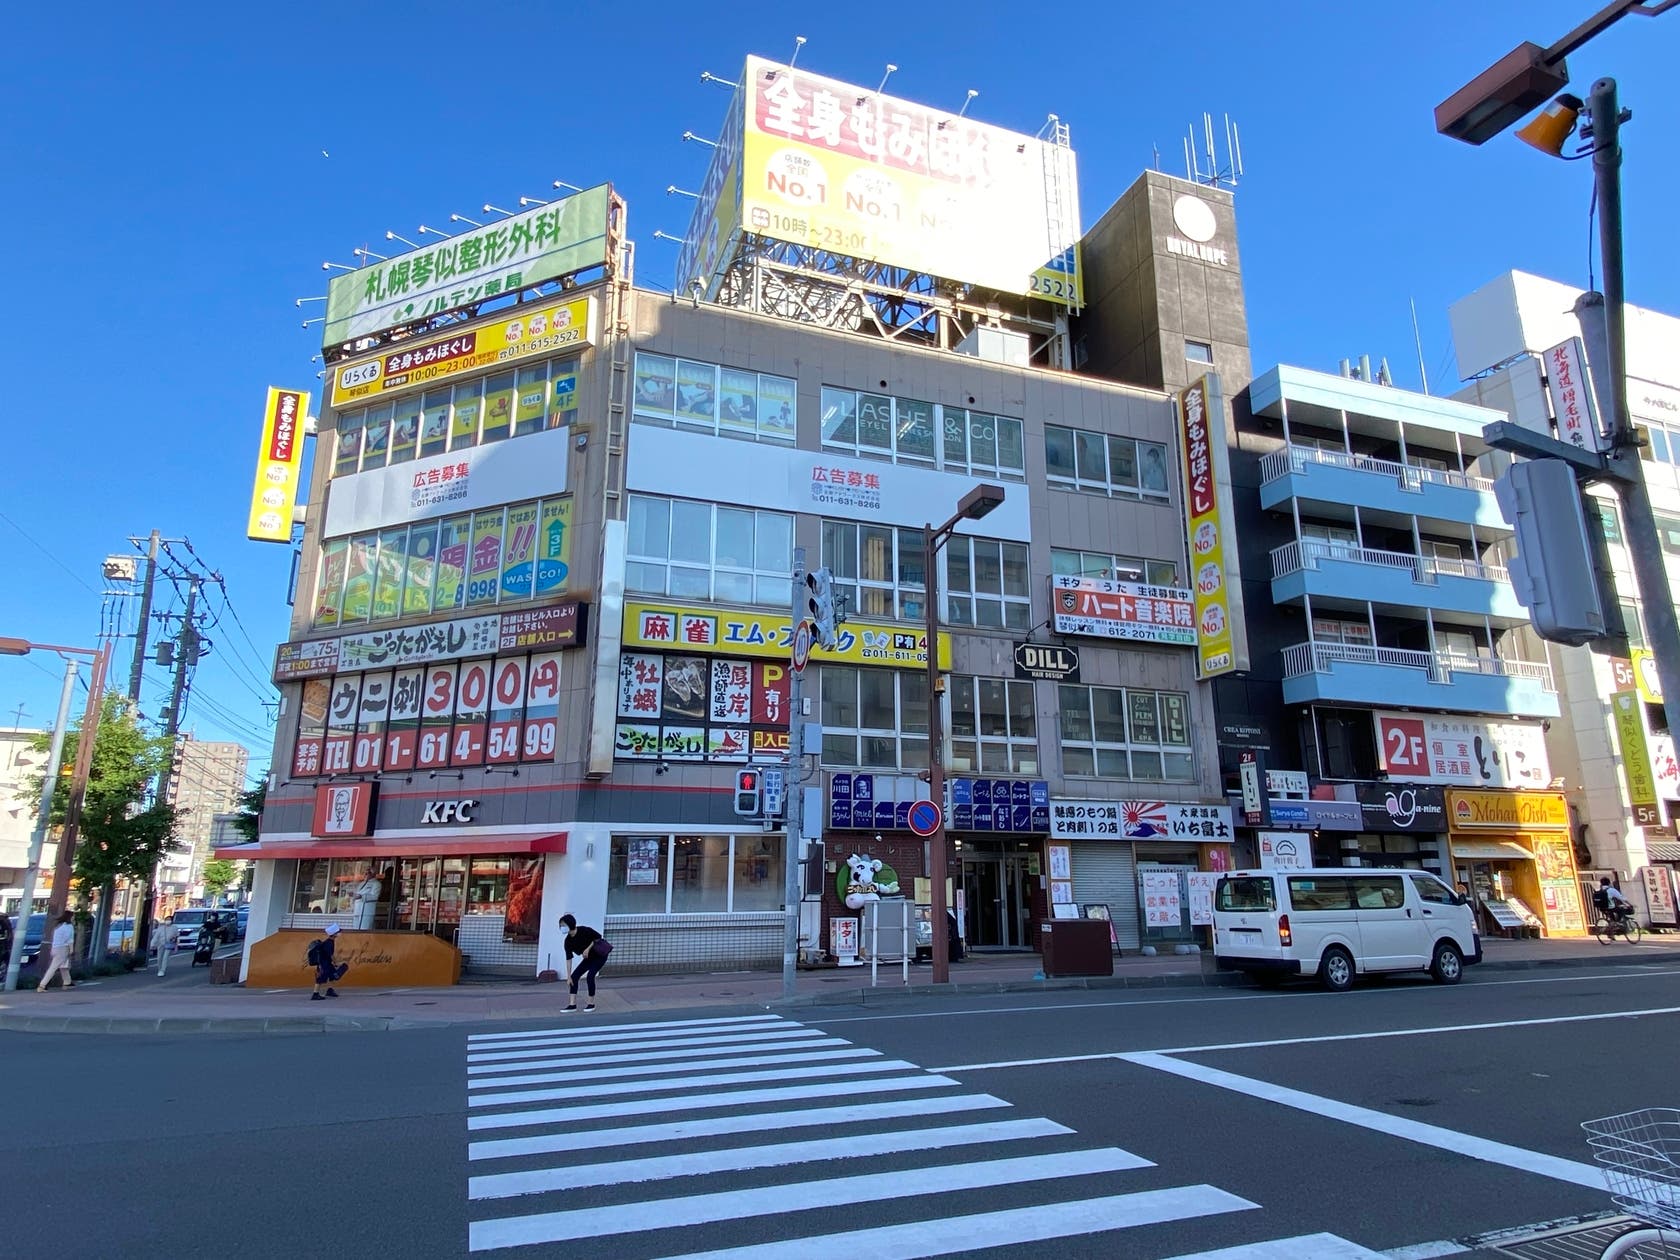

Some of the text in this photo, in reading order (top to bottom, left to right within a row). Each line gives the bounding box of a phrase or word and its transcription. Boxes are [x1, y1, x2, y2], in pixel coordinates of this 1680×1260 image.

[767, 171, 826, 203] No.1
[364, 208, 561, 305] 札幌琴似整形外科
[421, 272, 523, 316] ノルテン薬局
[1030, 274, 1076, 301] 2522
[528, 324, 548, 336] No.1
[552, 317, 572, 329] No.1
[505, 330, 524, 341] No.1
[508, 330, 579, 356] 011-615-2522
[387, 341, 473, 373] 全身もみほぐし
[344, 365, 378, 385] りらくる
[556, 395, 573, 408] 4F
[275, 395, 296, 459] 全身もみほぐし
[944, 417, 962, 435] &
[1185, 388, 1210, 513] 全身もみほぐし
[413, 462, 469, 488] 広告募集
[812, 466, 880, 489] 広告募集
[819, 495, 881, 509] 011-631-8266
[1194, 534, 1217, 553] No.1
[1059, 577, 1092, 589] ギター
[1137, 586, 1188, 601] 生徒募集中
[1198, 575, 1221, 593] No.1
[1081, 593, 1193, 626] ハート音楽院
[643, 615, 711, 644] 麻雀
[1202, 617, 1226, 635] No.1
[367, 622, 467, 664] ごったがえし
[502, 637, 515, 648] 2F
[517, 631, 556, 646] 店舗入口
[894, 634, 915, 649] P有
[1025, 648, 1069, 669] DILL
[1206, 655, 1229, 670] りらくる
[1615, 662, 1633, 685] 5F
[333, 658, 560, 720] ウニ刺300円
[727, 665, 750, 718] 厚岸
[733, 731, 748, 740] 2F
[763, 734, 789, 748] 入口
[325, 722, 556, 770] TEL 011-614-5499
[1387, 727, 1424, 766] 2F
[1432, 741, 1469, 757] 個室
[1242, 753, 1252, 763] 2F
[1622, 714, 1650, 799] 琴似くどう歯科
[1435, 760, 1472, 775] 居酒屋
[832, 784, 850, 794] 川田
[421, 800, 474, 823] KFC
[1054, 805, 1118, 819] 魅惑のもつ鍋
[1179, 807, 1219, 818] 大衆酒場
[1472, 799, 1548, 824] Mohan Dish
[1637, 807, 1656, 822] 5F
[1173, 820, 1229, 838] いち富士
[1145, 877, 1179, 888] ごった
[1145, 896, 1179, 908] 営業中
[1149, 911, 1180, 922] 2階へ
[841, 920, 853, 945] ギター
